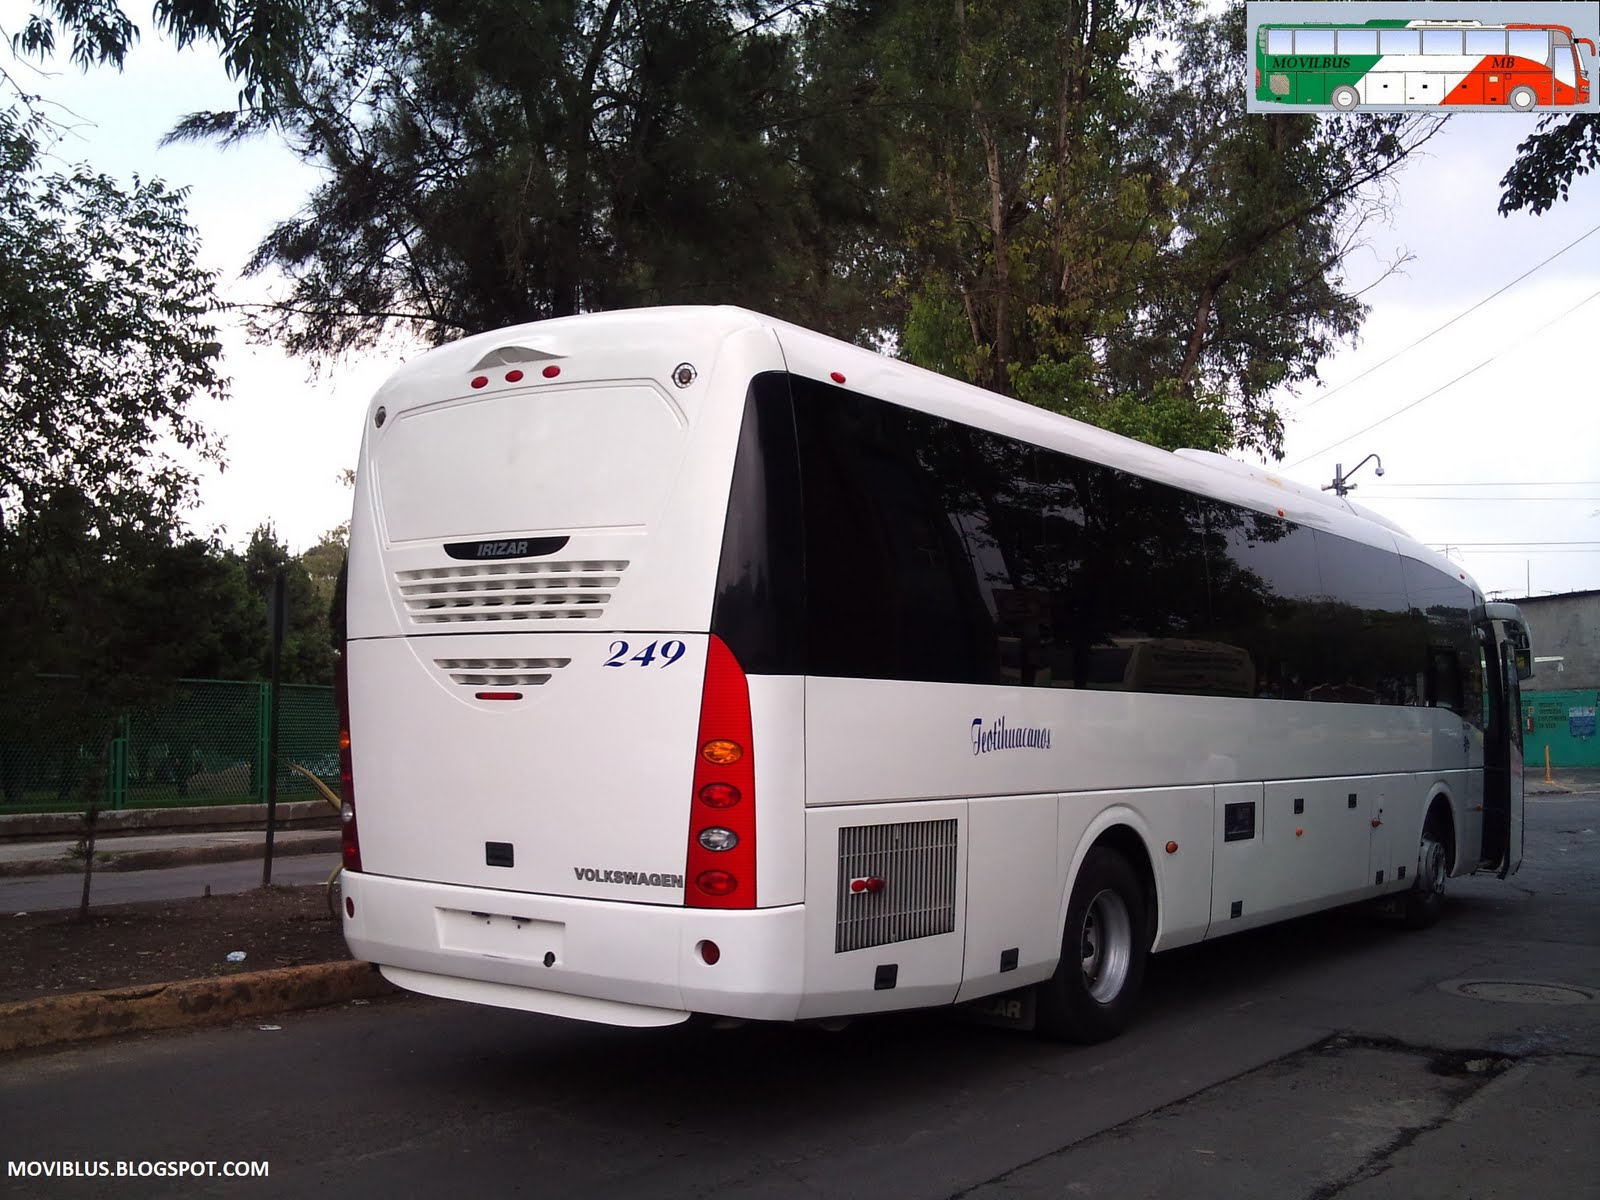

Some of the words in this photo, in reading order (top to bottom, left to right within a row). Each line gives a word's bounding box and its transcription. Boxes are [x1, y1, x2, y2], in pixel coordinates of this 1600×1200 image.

[476, 541, 529, 557] IRIZAR
[602, 640, 686, 669] 249
[971, 715, 1051, 756] Teotihuacanos
[574, 867, 684, 888] VOLKSWAGEN
